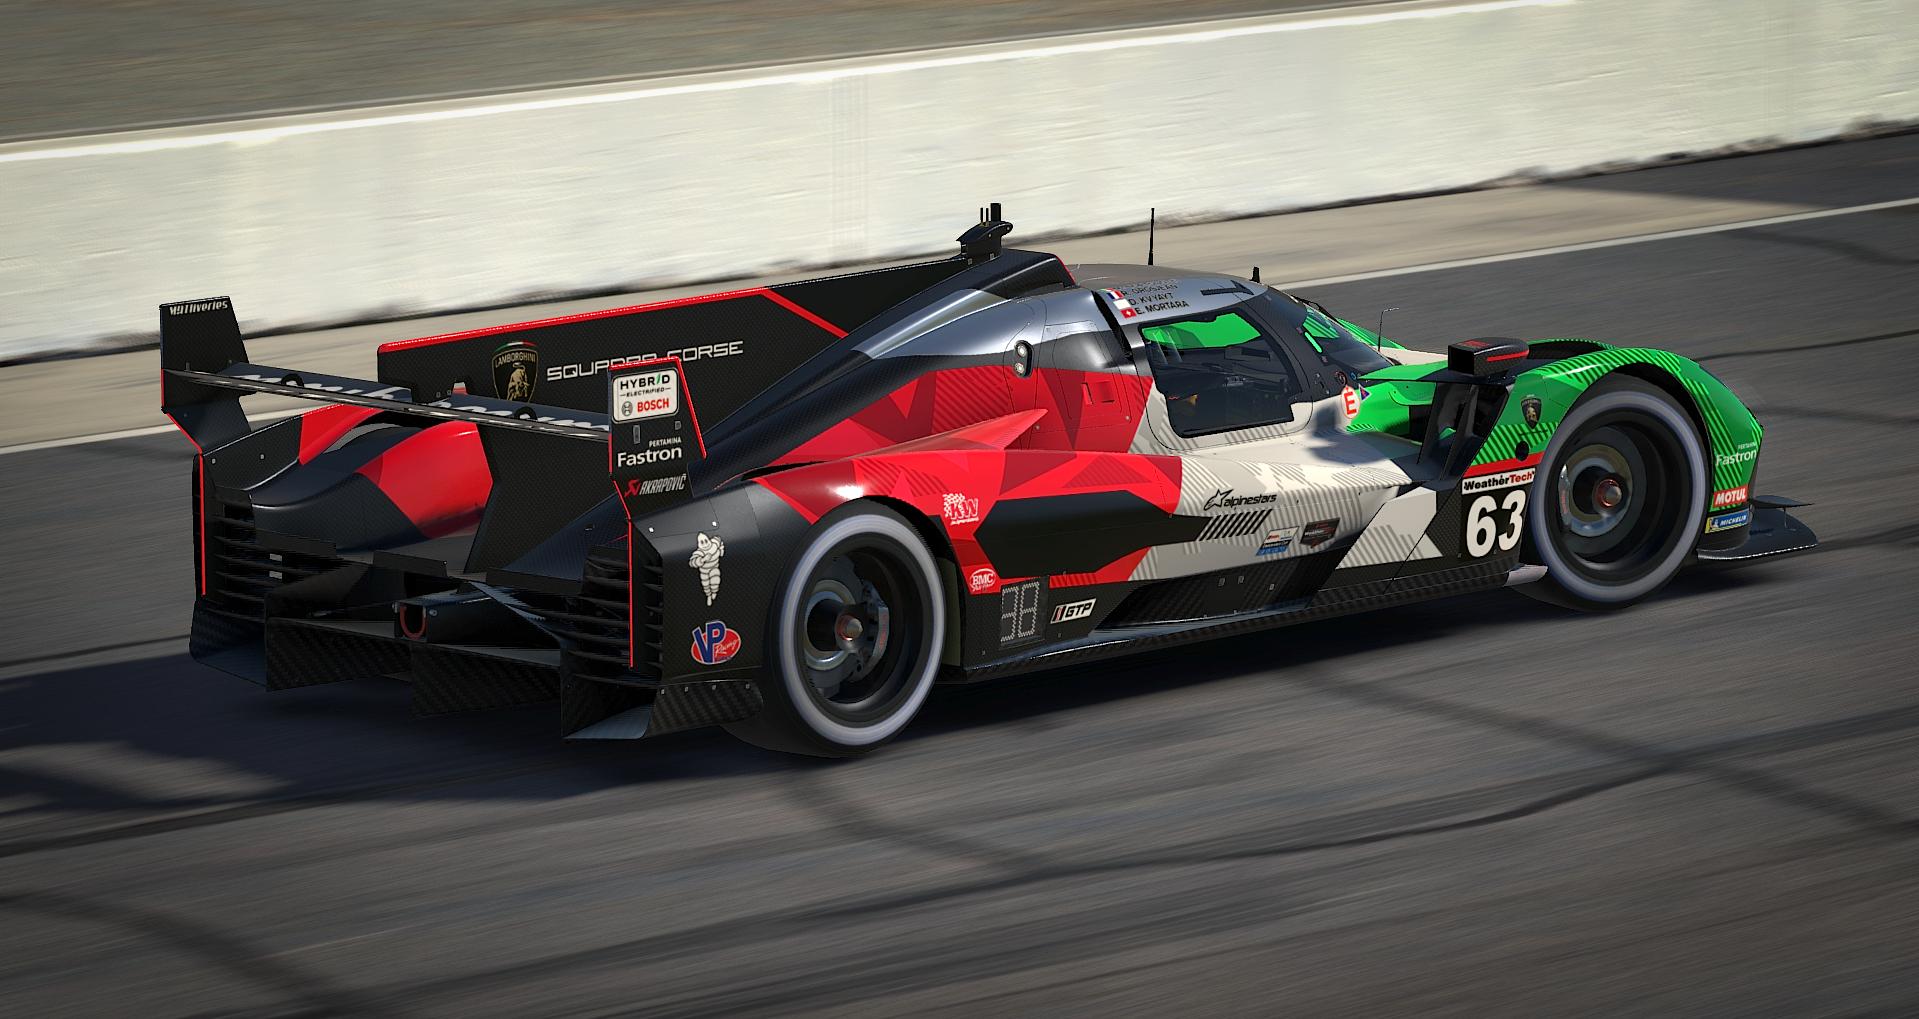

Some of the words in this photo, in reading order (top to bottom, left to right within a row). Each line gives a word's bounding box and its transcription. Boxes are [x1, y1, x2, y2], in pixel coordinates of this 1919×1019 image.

[1145, 301, 1189, 313] MORTARA
[495, 351, 536, 368] LAMBORGHINI
[620, 374, 670, 390] HYBRID
[626, 386, 665, 397] ELECTRIFIED
[637, 398, 669, 412] BOSCH
[649, 437, 681, 448] PERTAMINA
[617, 447, 682, 467] Fastron
[1716, 449, 1757, 466] Fastron
[1464, 470, 1534, 490] WeatherTech
[1223, 494, 1277, 508] alpinestars
[1715, 487, 1746, 505] MOTUL
[950, 498, 979, 520] KW
[1466, 489, 1526, 558] 63
[1720, 514, 1747, 527] MICHELIN
[972, 573, 994, 585] BMC
[1064, 601, 1093, 618] GTP
[692, 620, 726, 664] VP
